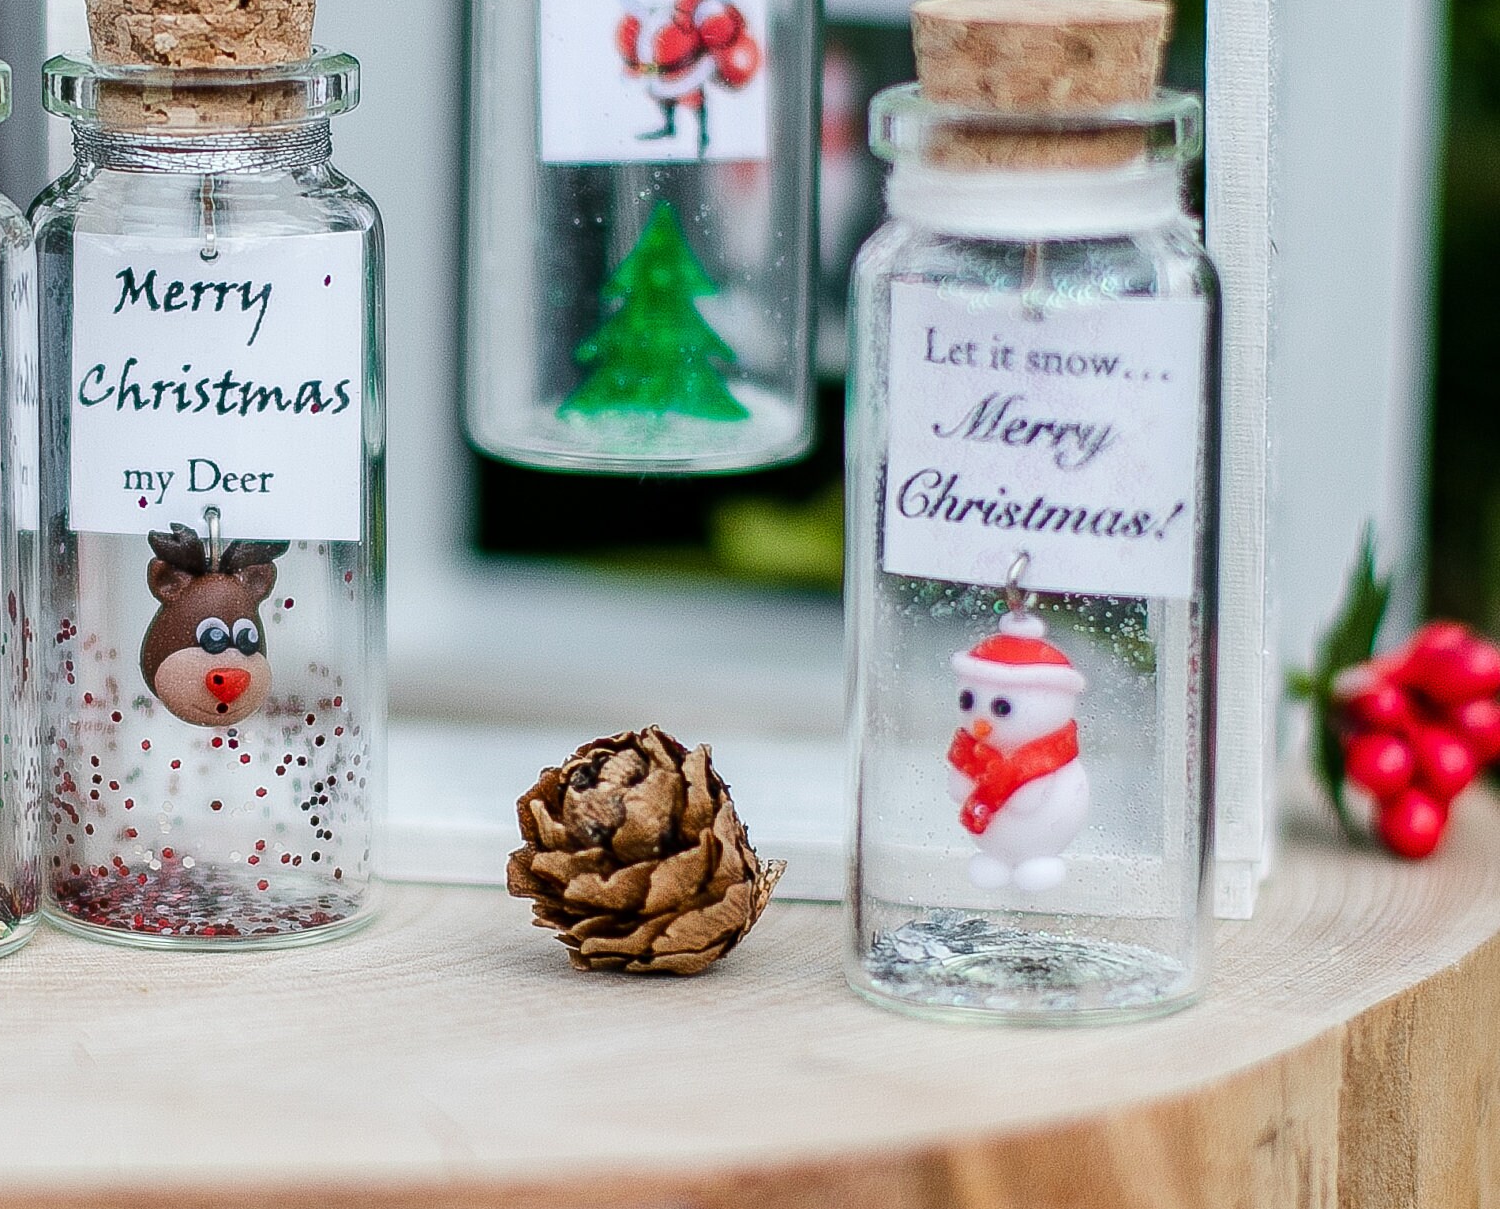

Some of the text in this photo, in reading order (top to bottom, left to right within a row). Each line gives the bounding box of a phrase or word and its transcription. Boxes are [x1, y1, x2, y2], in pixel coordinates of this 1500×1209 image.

[112, 265, 273, 347] Merry
[924, 325, 1172, 382] Let it snow...
[78, 357, 352, 417] Christmas
[931, 391, 1120, 472] Merry
[123, 457, 275, 505] my Deer
[896, 468, 1187, 540] Christmas!
